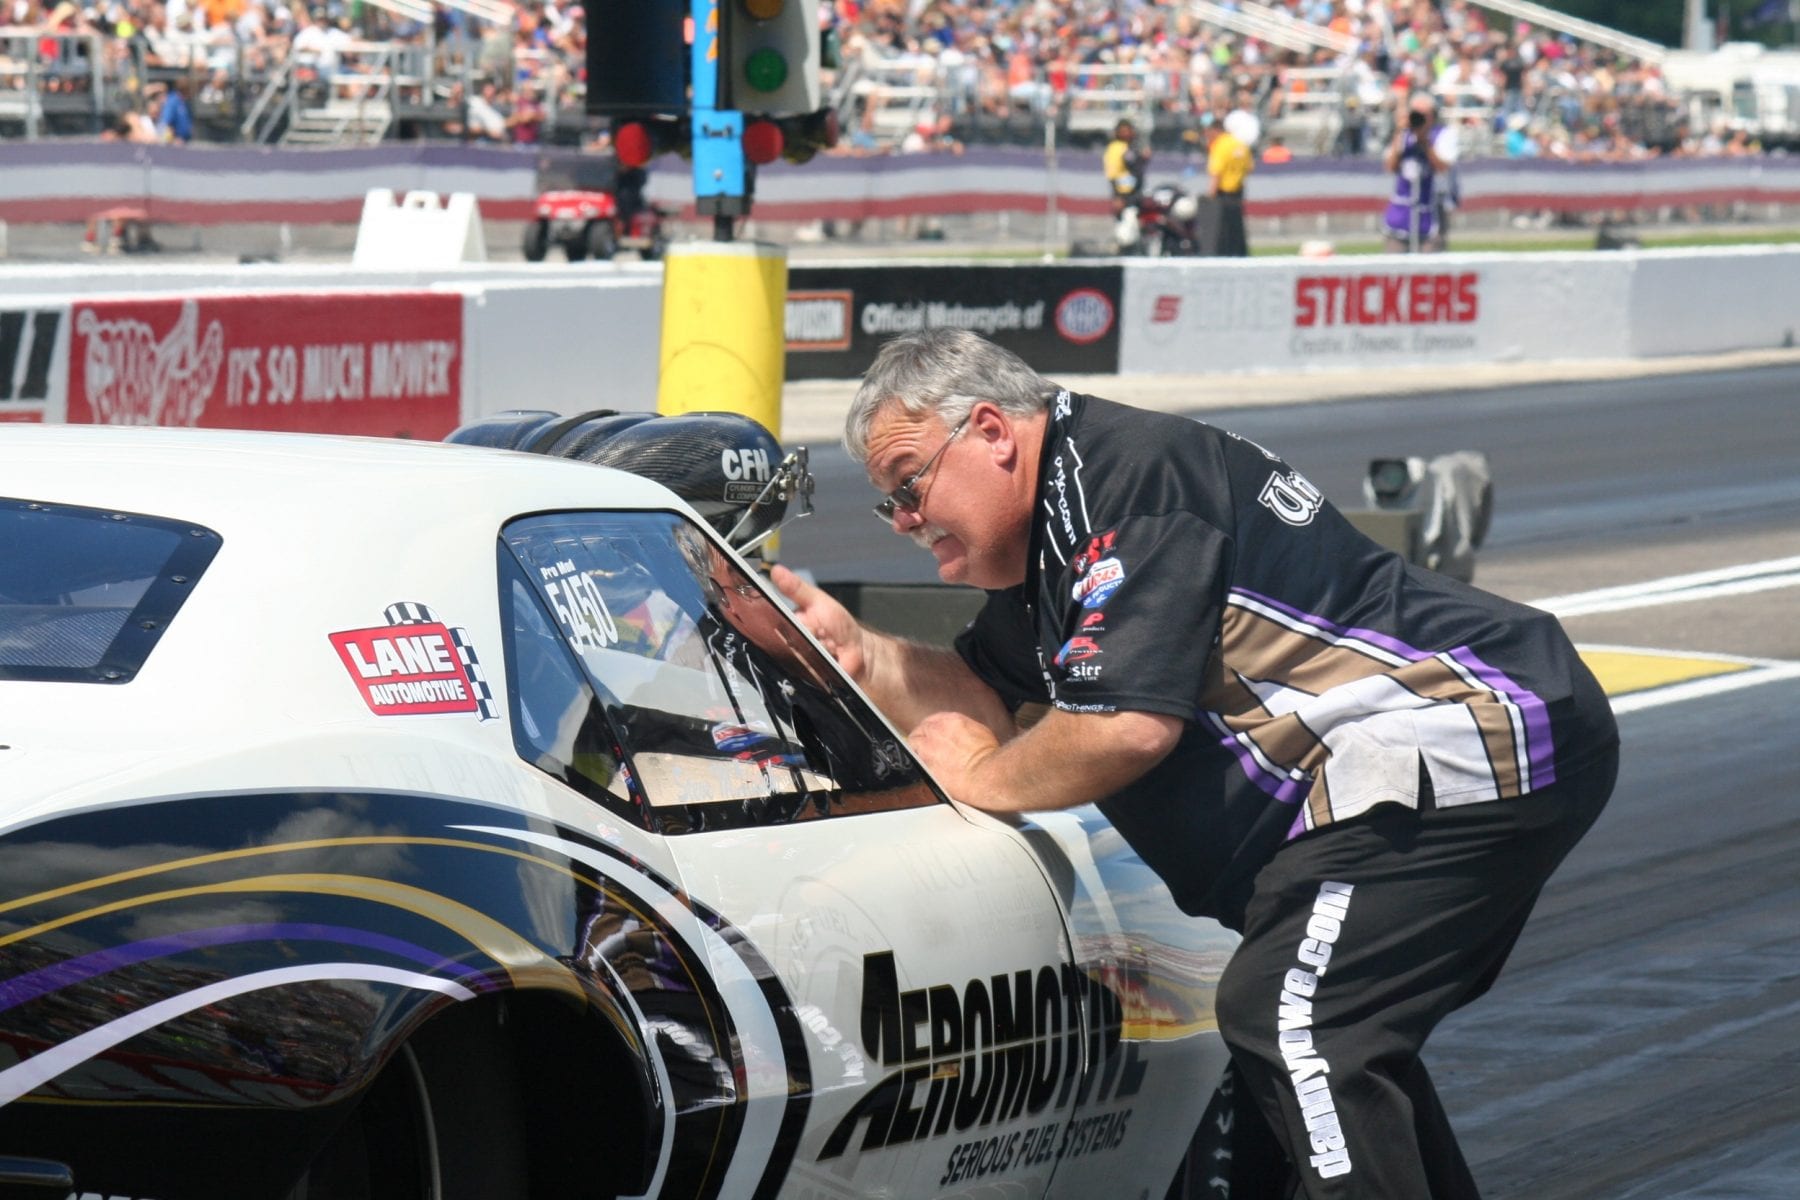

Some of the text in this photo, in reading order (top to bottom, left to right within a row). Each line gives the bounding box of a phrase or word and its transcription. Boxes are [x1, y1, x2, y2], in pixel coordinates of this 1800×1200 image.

[926, 301, 1021, 334] Motorcycle
[1023, 301, 1045, 329] of
[1294, 273, 1479, 327] STICKERS
[267, 345, 298, 405] SO
[302, 342, 364, 402] MUCH
[370, 339, 456, 399] MOWER
[540, 558, 577, 581] Pro Mod
[544, 571, 619, 656] 5450
[344, 634, 456, 679] LANE
[368, 678, 468, 707] AUTOMOTIVE
[939, 1108, 1133, 1187] SERIOUS FUEL SYSTEMS
